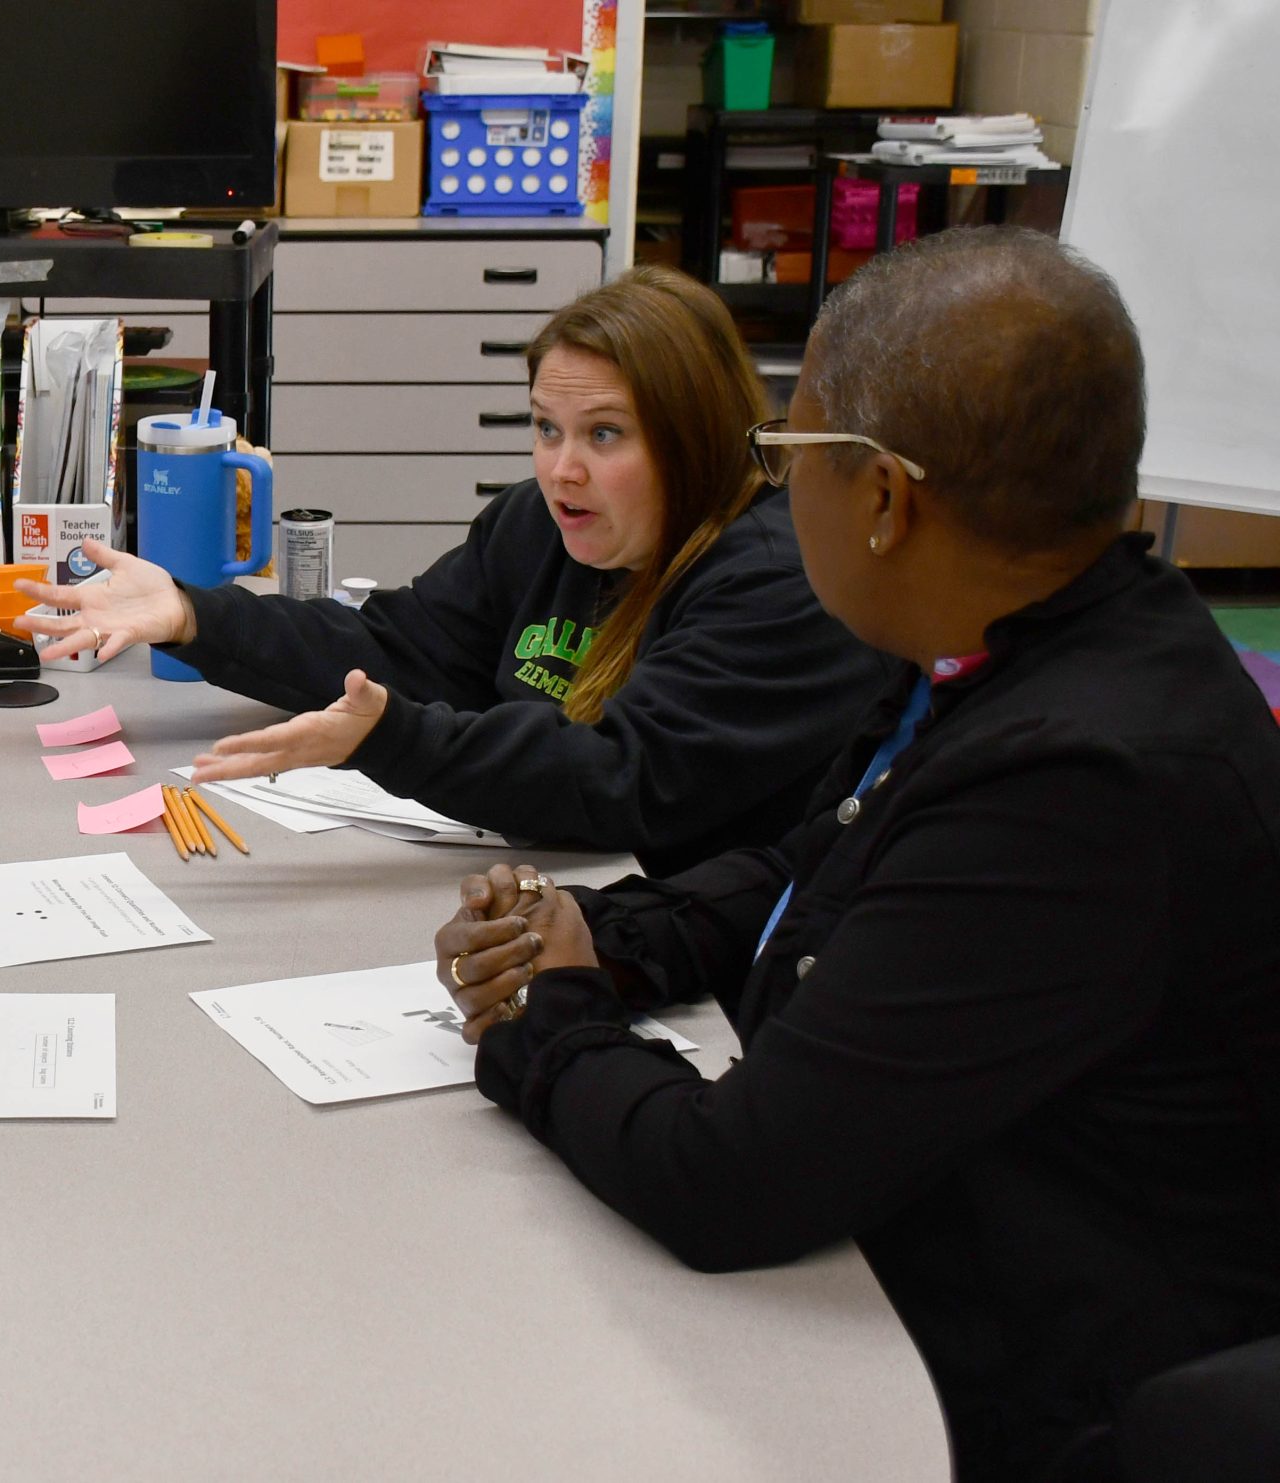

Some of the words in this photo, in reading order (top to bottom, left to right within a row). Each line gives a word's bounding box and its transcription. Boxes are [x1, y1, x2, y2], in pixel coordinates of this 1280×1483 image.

[23, 515, 37, 526] Do
[63, 520, 100, 530] Teacher
[23, 526, 41, 536] The
[60, 531, 105, 541] Bookcase
[23, 536, 48, 546] Math
